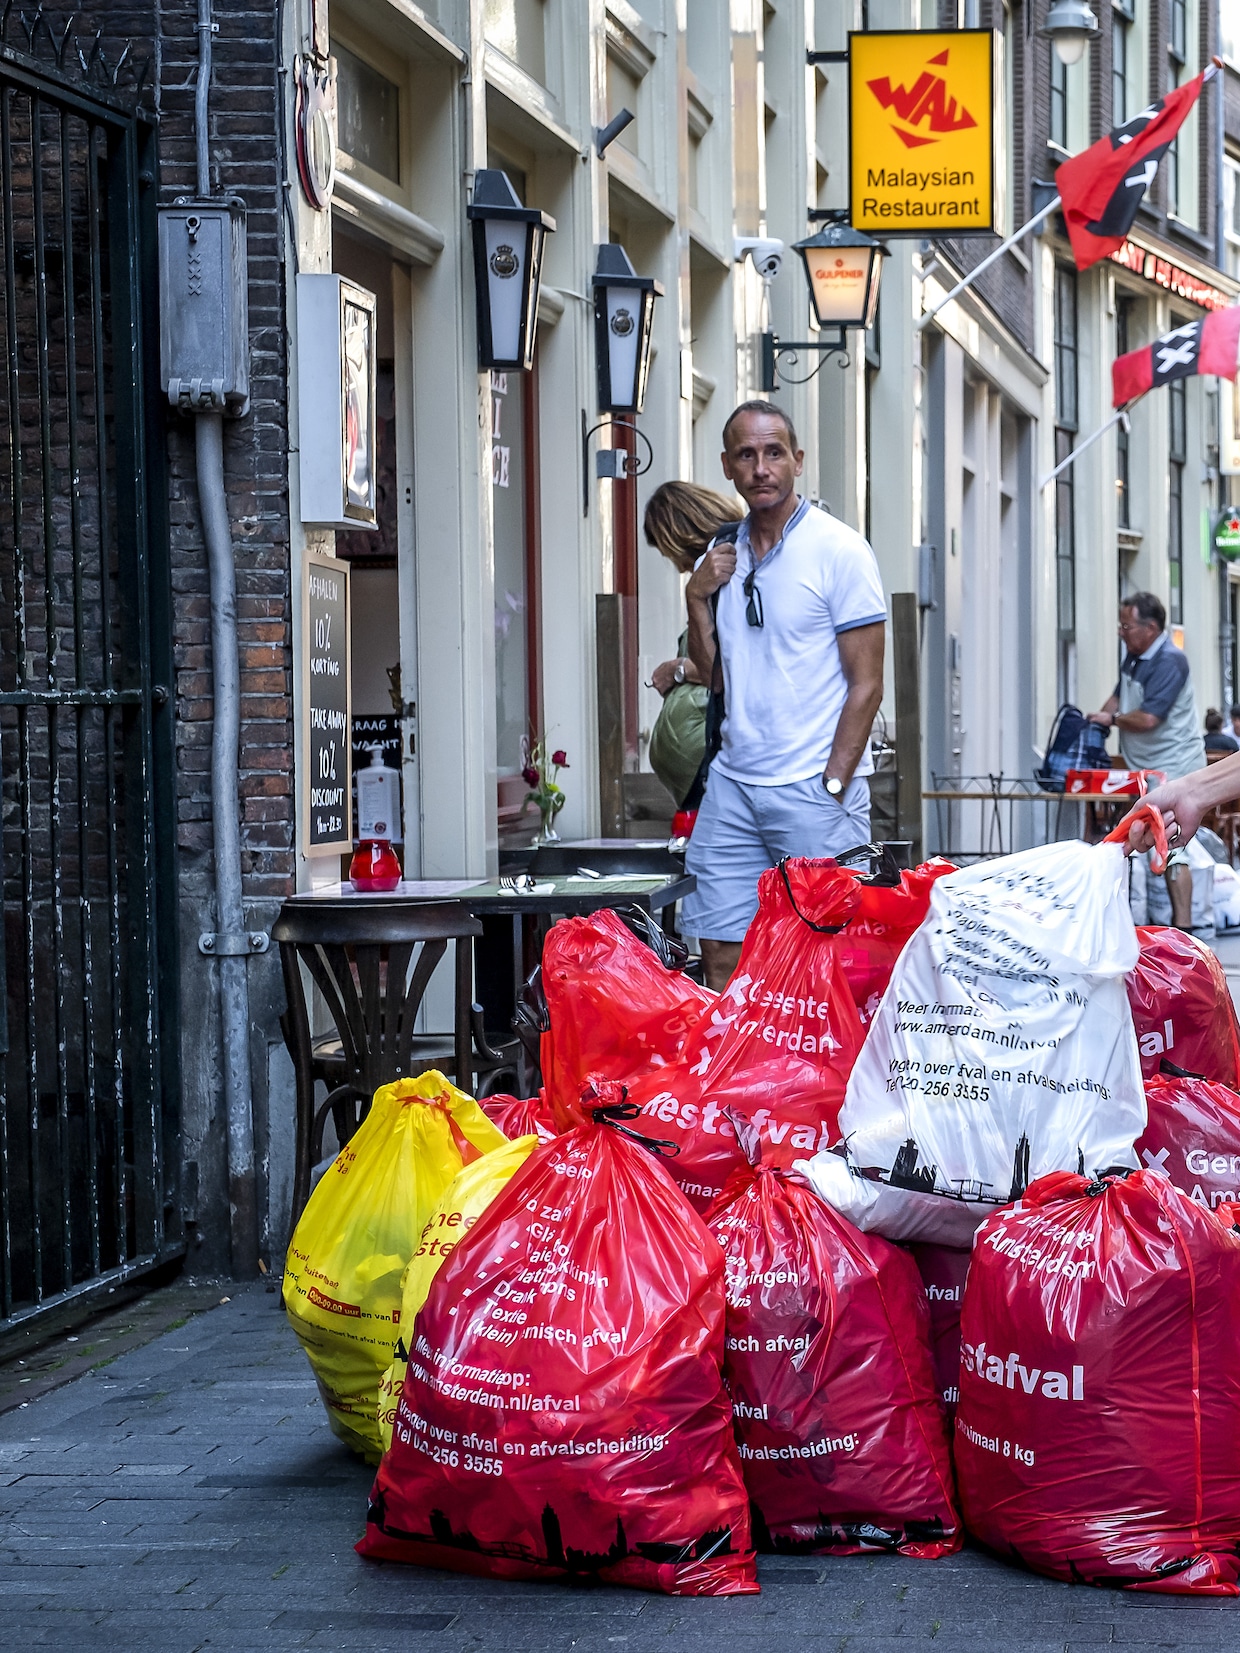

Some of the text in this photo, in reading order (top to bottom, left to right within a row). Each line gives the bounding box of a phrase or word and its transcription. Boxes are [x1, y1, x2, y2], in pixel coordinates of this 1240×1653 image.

[867, 168, 974, 191] Malaysian
[863, 198, 980, 217] Restaurant
[815, 269, 864, 279] GULPENER
[308, 574, 338, 602] AFHALEN
[310, 708, 327, 730] TAKE
[319, 740, 337, 780] 10%
[311, 787, 345, 808] DISCOUNT
[924, 1062, 955, 1076] over
[991, 1069, 1012, 1083] en
[984, 1227, 1096, 1280] Amsterdam
[360, 1335, 376, 1345] afval
[377, 1339, 390, 1347] van
[467, 1317, 519, 1348] (klein)
[583, 1326, 628, 1348] afval
[765, 1334, 810, 1351] afval
[960, 1342, 1084, 1401] stafval
[396, 1421, 411, 1444] Tel
[463, 1453, 503, 1476] 3555
[429, 1425, 458, 1444] over
[462, 1432, 498, 1453] afval
[503, 1443, 525, 1455] en
[1003, 1440, 1010, 1457] 8
[1014, 1443, 1035, 1466] kg
